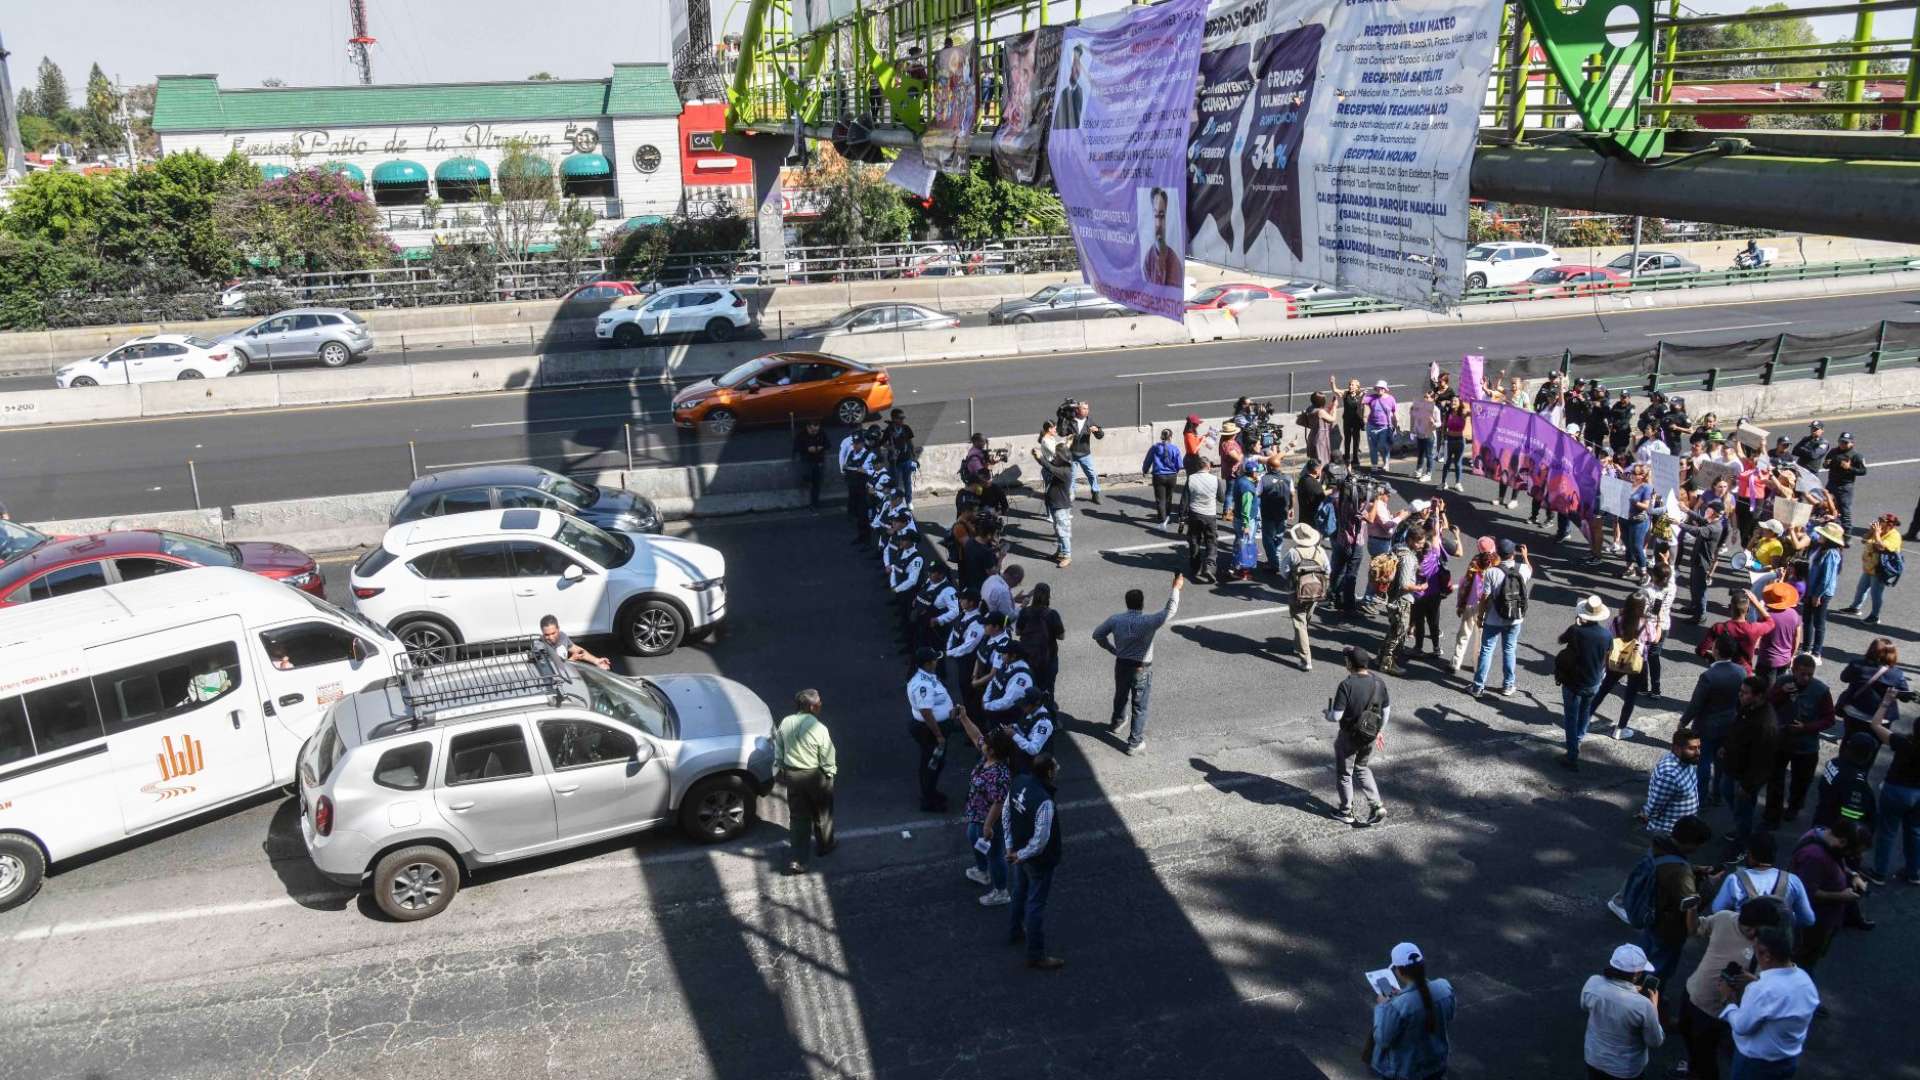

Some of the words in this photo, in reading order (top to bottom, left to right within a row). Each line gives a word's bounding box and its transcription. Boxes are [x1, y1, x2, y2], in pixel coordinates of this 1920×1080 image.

[1427, 16, 1457, 32] MATEO
[1267, 68, 1304, 88] GRUPOS
[1410, 67, 1443, 83] SATÉLITE
[299, 129, 368, 157] Patio
[384, 127, 408, 153] de
[1252, 134, 1288, 170] 34%
[1386, 150, 1417, 163] MOLINO
[1379, 199, 1408, 212] PARQUE
[1410, 203, 1447, 217] NAUCALLI
